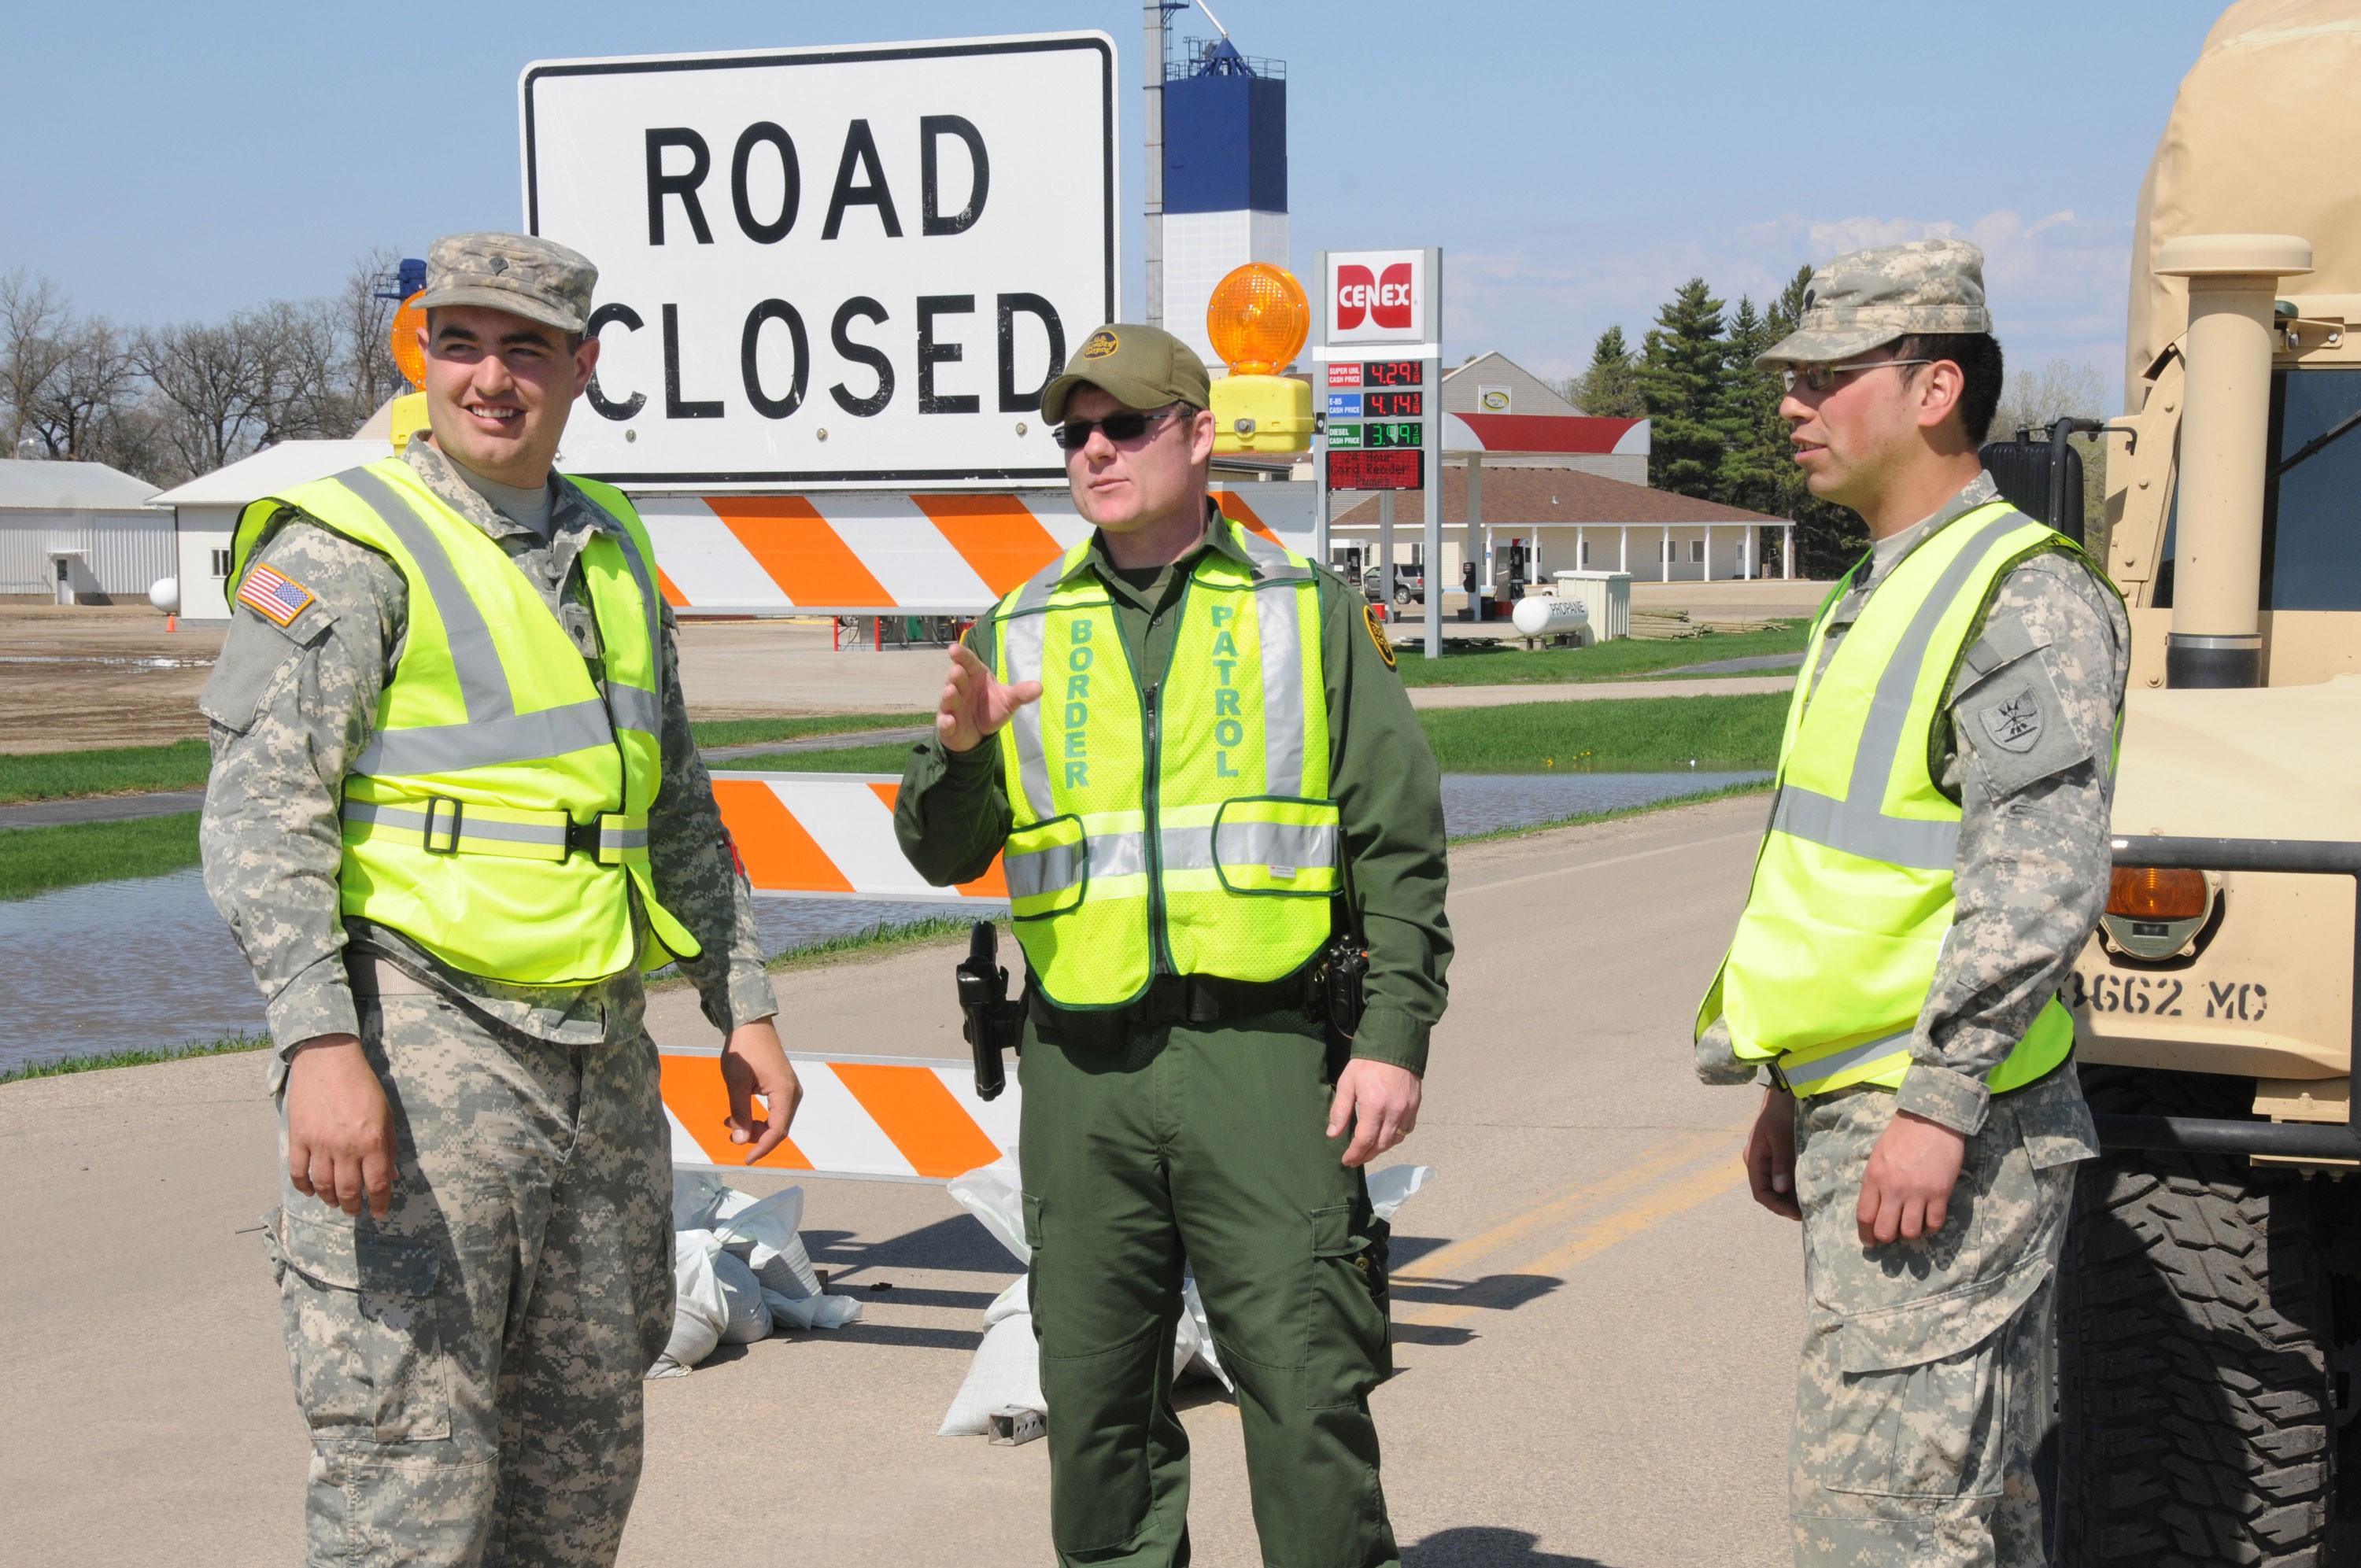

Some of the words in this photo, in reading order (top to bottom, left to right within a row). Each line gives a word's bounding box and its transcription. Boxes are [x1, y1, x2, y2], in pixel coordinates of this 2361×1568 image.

[645, 114, 990, 245] ROAD
[1339, 283, 1410, 308] CENEX
[585, 293, 1066, 421] CLOSED
[1372, 363, 1410, 384] 4.29
[1372, 395, 1410, 414] 4.14
[1373, 425, 1410, 445] 3.99
[1344, 452, 1358, 463] 24
[1366, 451, 1393, 463] Hour
[1331, 463, 1360, 475] Card
[1367, 463, 1410, 474] Reader
[1355, 475, 1391, 486] Pumps
[1549, 601, 1585, 615] PROPANE
[1211, 606, 1243, 778] PATROL
[1065, 620, 1092, 789] BORDER
